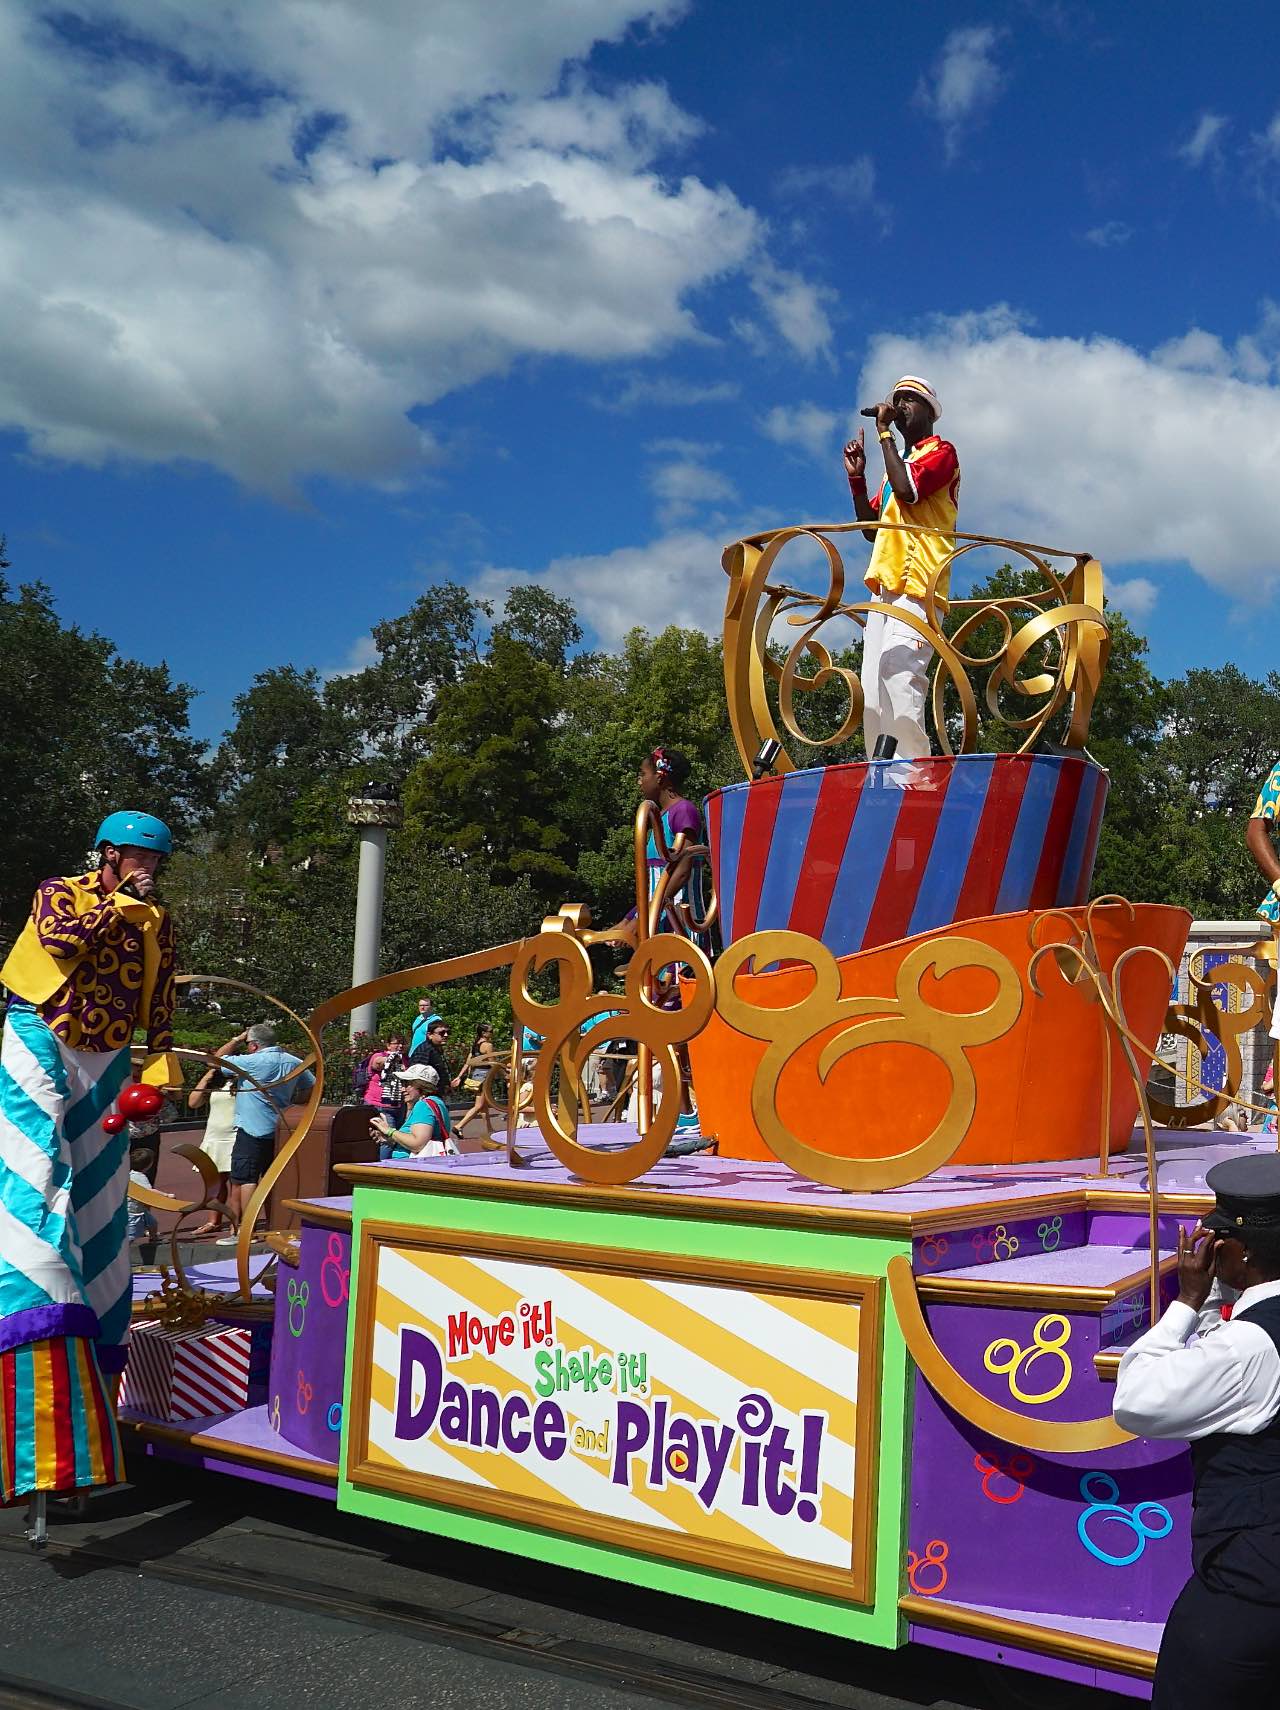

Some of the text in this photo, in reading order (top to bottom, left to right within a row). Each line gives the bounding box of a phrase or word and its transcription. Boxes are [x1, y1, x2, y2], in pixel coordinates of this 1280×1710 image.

[448, 1301, 553, 1357] Move it!
[394, 1328, 567, 1460] Dance
[574, 1420, 610, 1453] and
[534, 1349, 647, 1397] Shake it!
